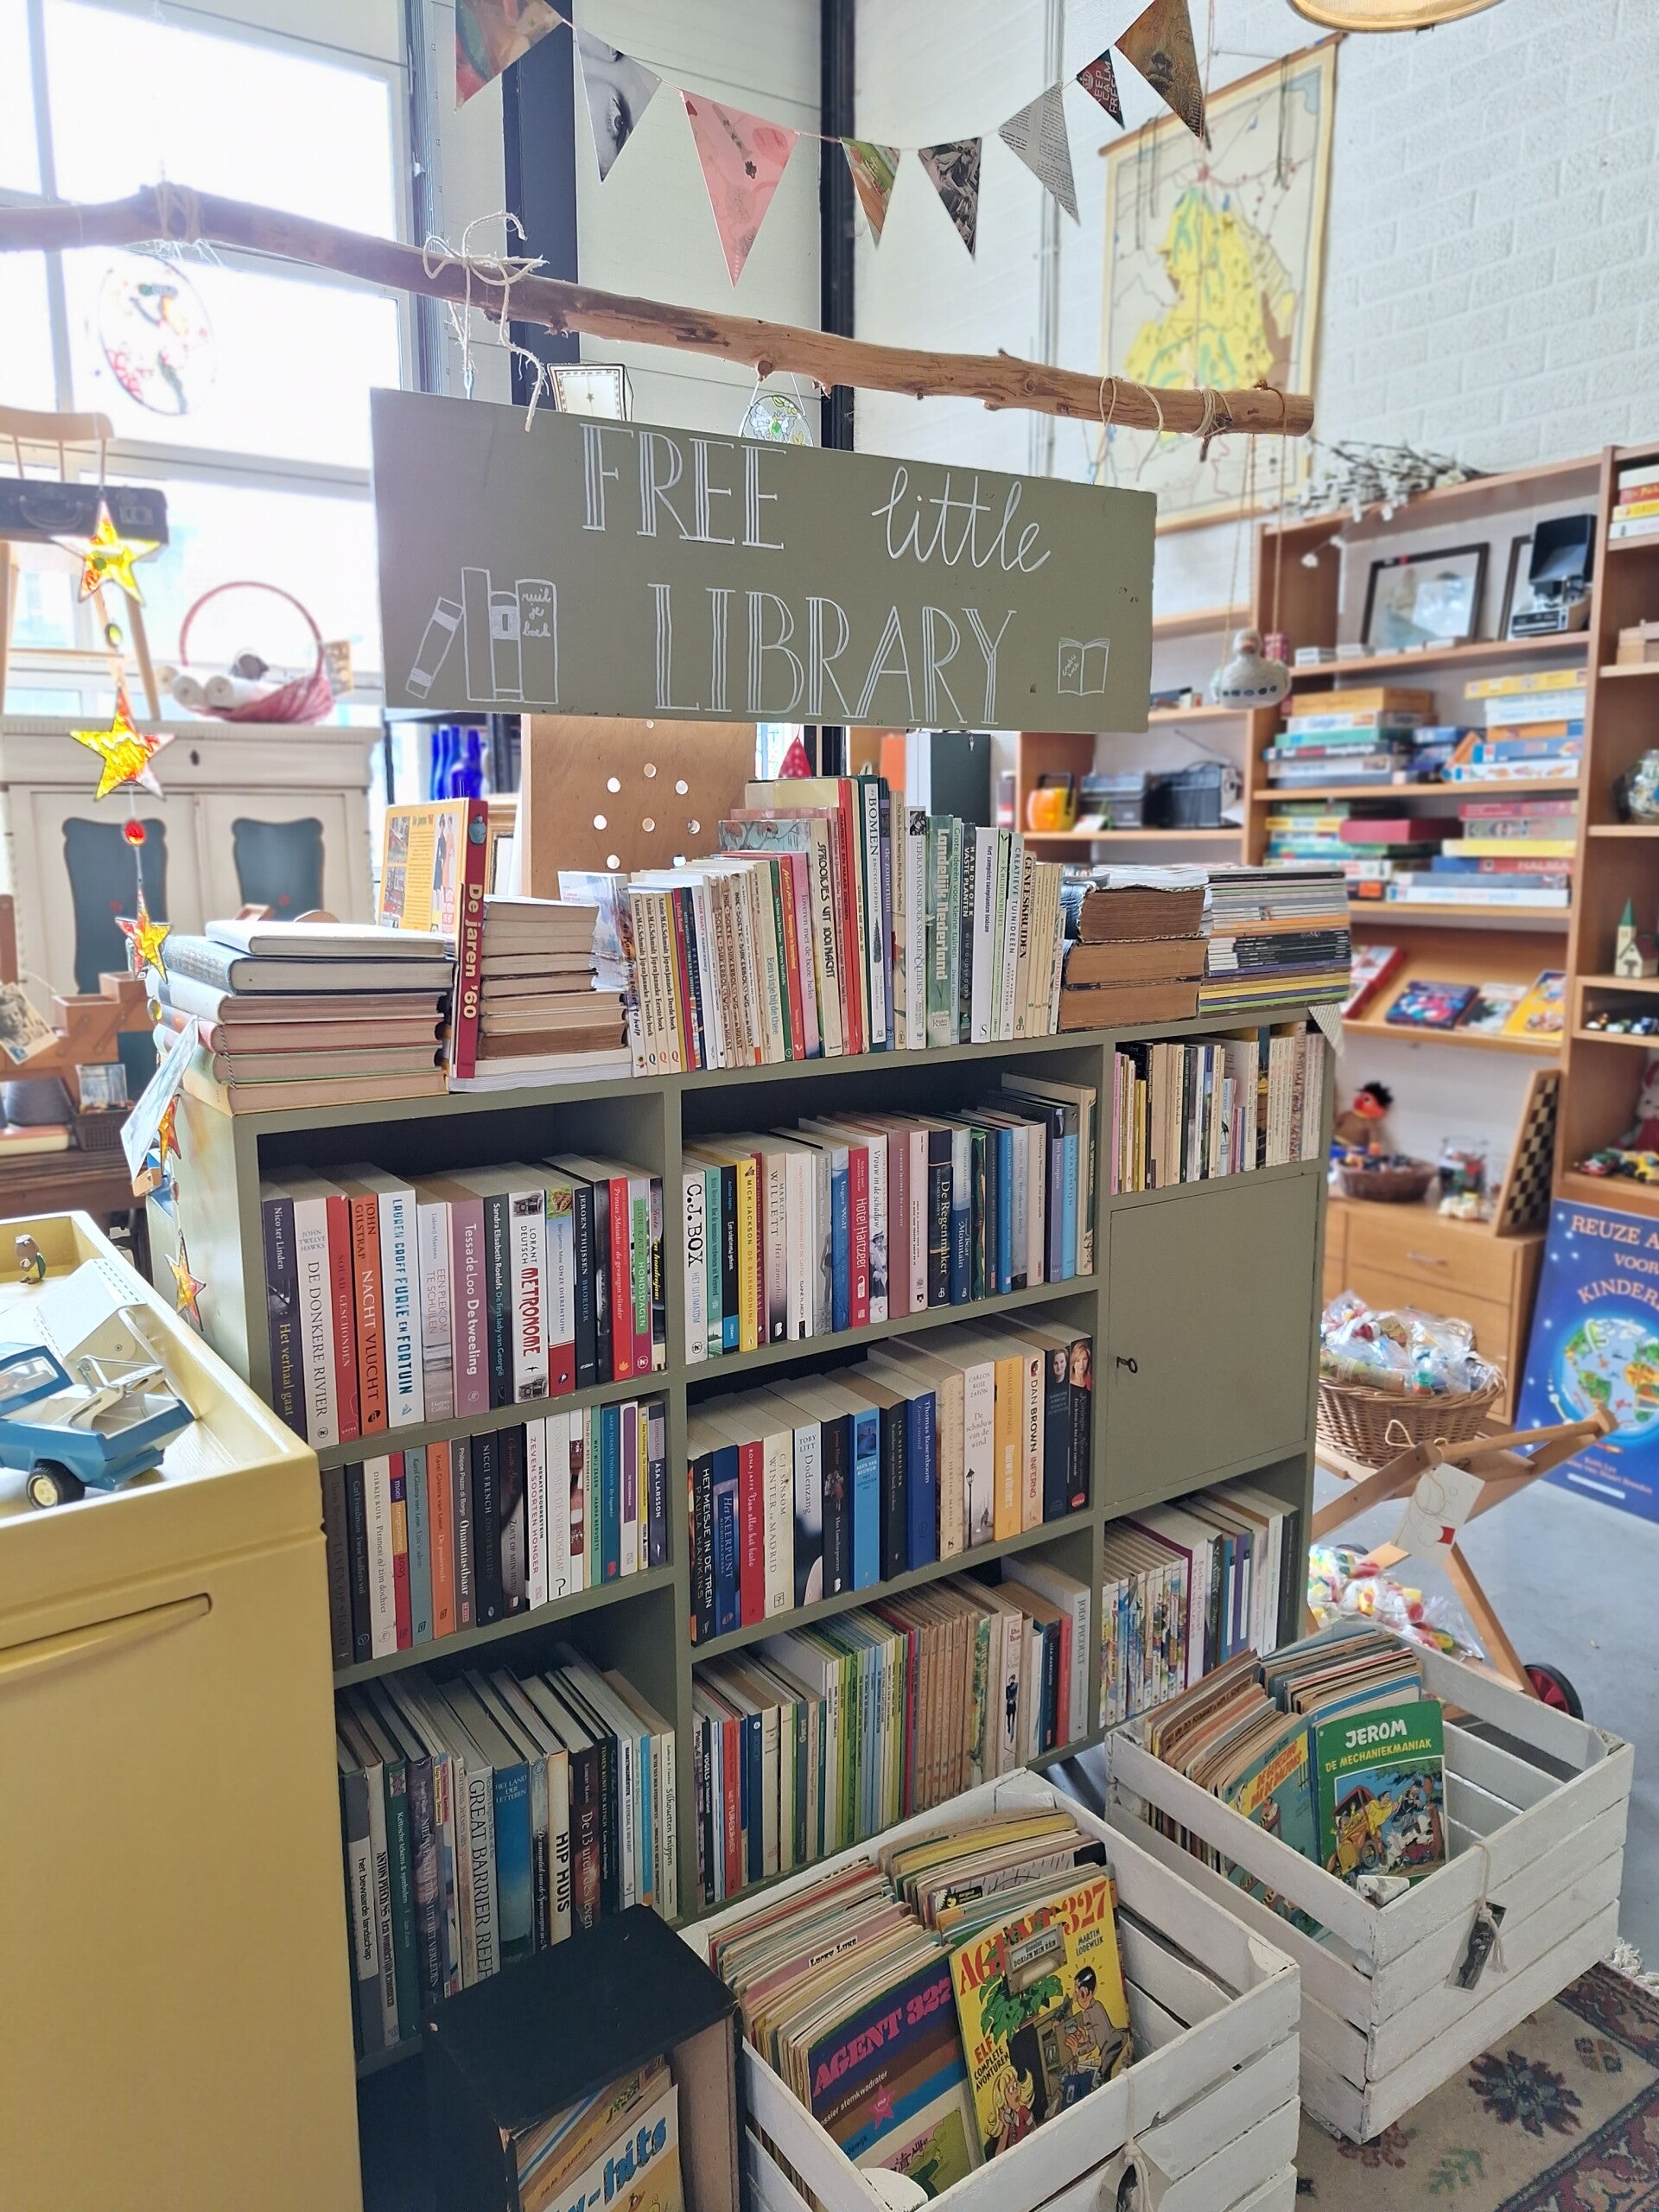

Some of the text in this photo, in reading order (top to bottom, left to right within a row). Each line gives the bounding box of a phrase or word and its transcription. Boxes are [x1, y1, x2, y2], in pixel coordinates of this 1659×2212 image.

[1094, 70, 1103, 103] EEP
[579, 423, 1051, 574] FREE little
[647, 583, 1018, 726] LIBRARY
[817, 842, 830, 901] SPROOKJES
[885, 848, 891, 860] de
[936, 828, 950, 980] Landelijk Nederland
[997, 866, 1007, 928] KRUIDENBIJBEL
[1020, 855, 1033, 958] GENEESKRUIDEN
[463, 883, 483, 1019] De jaren '60
[354, 1205, 365, 1259] GILSTRAP
[365, 1202, 376, 1236] JOHN
[493, 1203, 501, 1228] Sandra
[770, 1170, 779, 1236] WILLETT
[854, 1198, 868, 1268] Hotel Hartzeer
[938, 1181, 951, 1274] De Regenmaker
[1572, 1215, 1641, 1246] REUZE
[274, 1207, 286, 1269] Nico ter Linden
[494, 1230, 504, 1262] Elisabeth
[521, 1226, 530, 1265] DEUTSCH
[686, 1184, 703, 1325] C.J. BOX HET ULTIMATUM
[747, 1250, 753, 1262] DE
[957, 1221, 965, 1268] Mountain
[392, 1198, 413, 1395] LAUREN GROFF FURIE EN FORTUIN
[427, 1271, 437, 1334] TE SCHUILEN
[437, 1268, 448, 1333] EEN PLEK OM
[465, 1224, 481, 1376] Tessa de Loo De tweeling
[495, 1262, 504, 1289] Roelofs
[496, 1291, 503, 1301] De
[307, 1262, 328, 1417] DE DONKERE RIVIER
[340, 1294, 351, 1367] GESCHONDEN
[361, 1269, 378, 1400] NACHT VLUCHT
[494, 1318, 504, 1333] lady
[518, 1267, 540, 1357] METRONOME
[279, 1323, 295, 1416] Het verhaal gaat
[1030, 1379, 1039, 1404] DAN
[483, 1444, 493, 1514] NICCI FRENCH
[803, 1454, 815, 1516] Dodenzang
[1029, 1456, 1038, 1497] INFERNO
[376, 1524, 385, 1556] Piranesi
[394, 1480, 405, 1579] mooi meegenomen 2005
[704, 1539, 711, 1553] IN
[724, 1497, 734, 1579] Het KEERPUNT
[704, 1555, 712, 1571] DE
[378, 1584, 387, 1613] dochter
[1325, 1738, 1432, 1772] DE MECHANIEKMANIAK
[1344, 1719, 1408, 1749] JEROM
[469, 1778, 493, 1979] GREAT BARRIER REEF
[556, 1831, 569, 1913] HIP HUIS
[580, 1811, 595, 1929] De 13 uren des leven
[358, 1858, 373, 1961] het bewaarde landschap
[1061, 1879, 1108, 1936] 327
[1077, 1927, 1100, 1945] MARTIN
[813, 1976, 952, 2098] AGENT 327
[974, 2034, 994, 2064] ELF
[974, 2047, 1005, 2081] COMPLETE
[976, 2052, 1011, 2093] AVONTUREN
